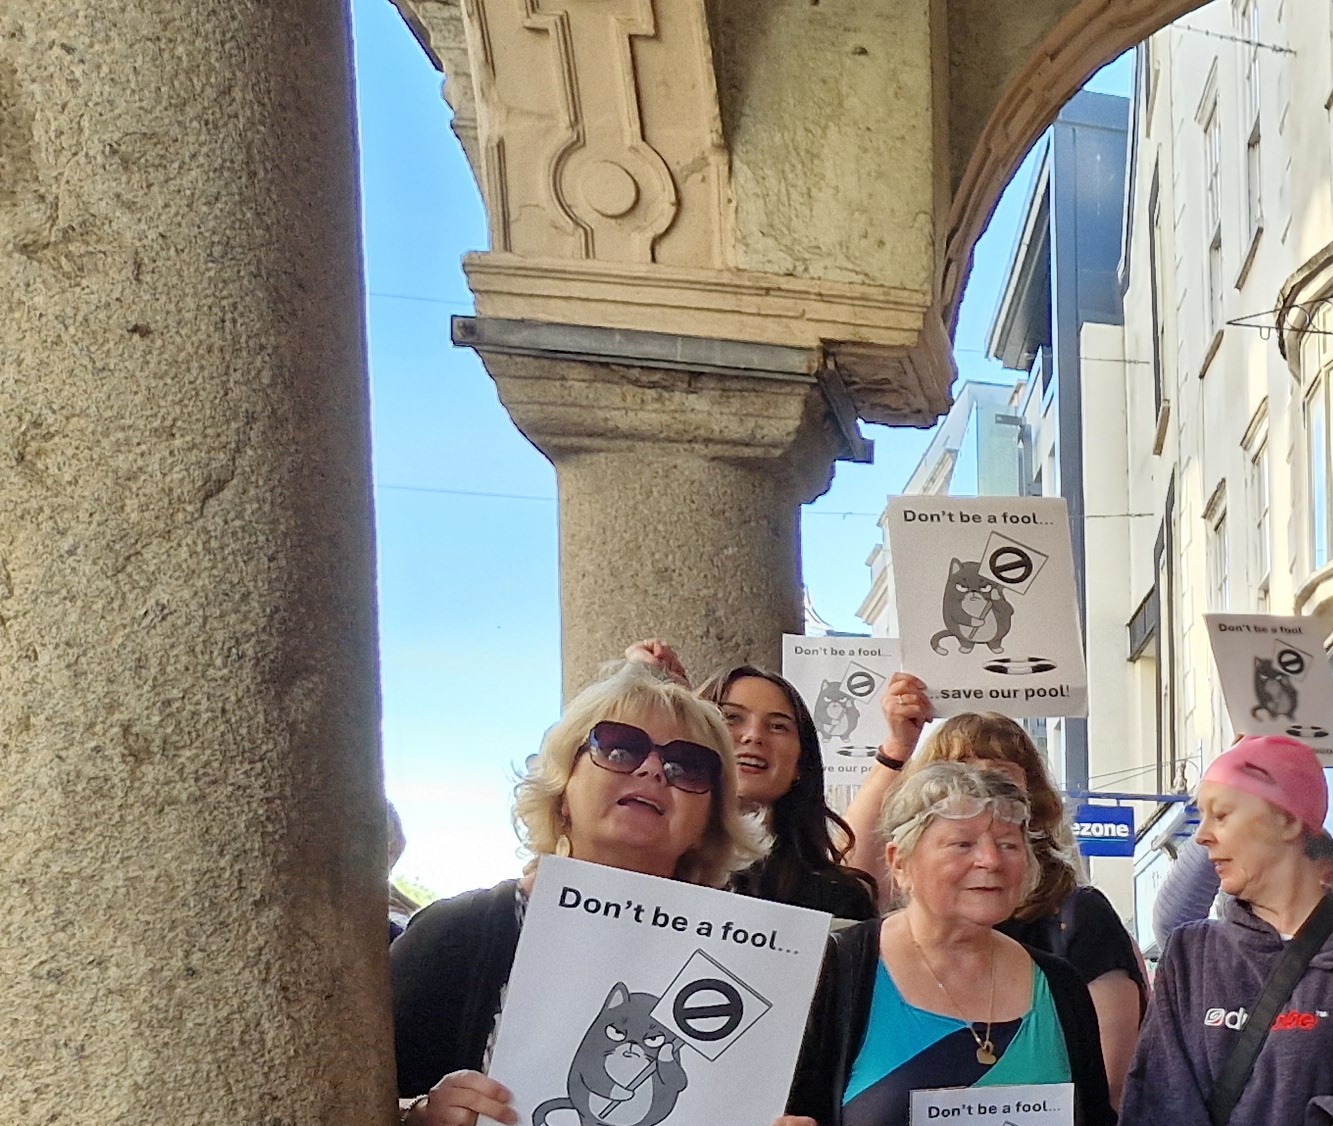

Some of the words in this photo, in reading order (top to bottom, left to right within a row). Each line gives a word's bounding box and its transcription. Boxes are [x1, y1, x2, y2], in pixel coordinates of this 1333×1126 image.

[959, 511, 982, 524] be
[987, 514, 997, 524] a
[830, 647, 846, 657] be
[848, 649, 856, 657] a
[989, 688, 1020, 700] our
[1024, 684, 1071, 701] pool!
[838, 765, 858, 773] our
[1071, 822, 1129, 837] ezone
[558, 886, 645, 924] Don't
[651, 906, 689, 932] be
[696, 921, 713, 937] a
[721, 921, 799, 955] fool...
[927, 1104, 974, 1119] Don't
[977, 1102, 997, 1115] be
[1002, 1103, 1011, 1114] a
[1015, 1100, 1061, 1113] fool...
